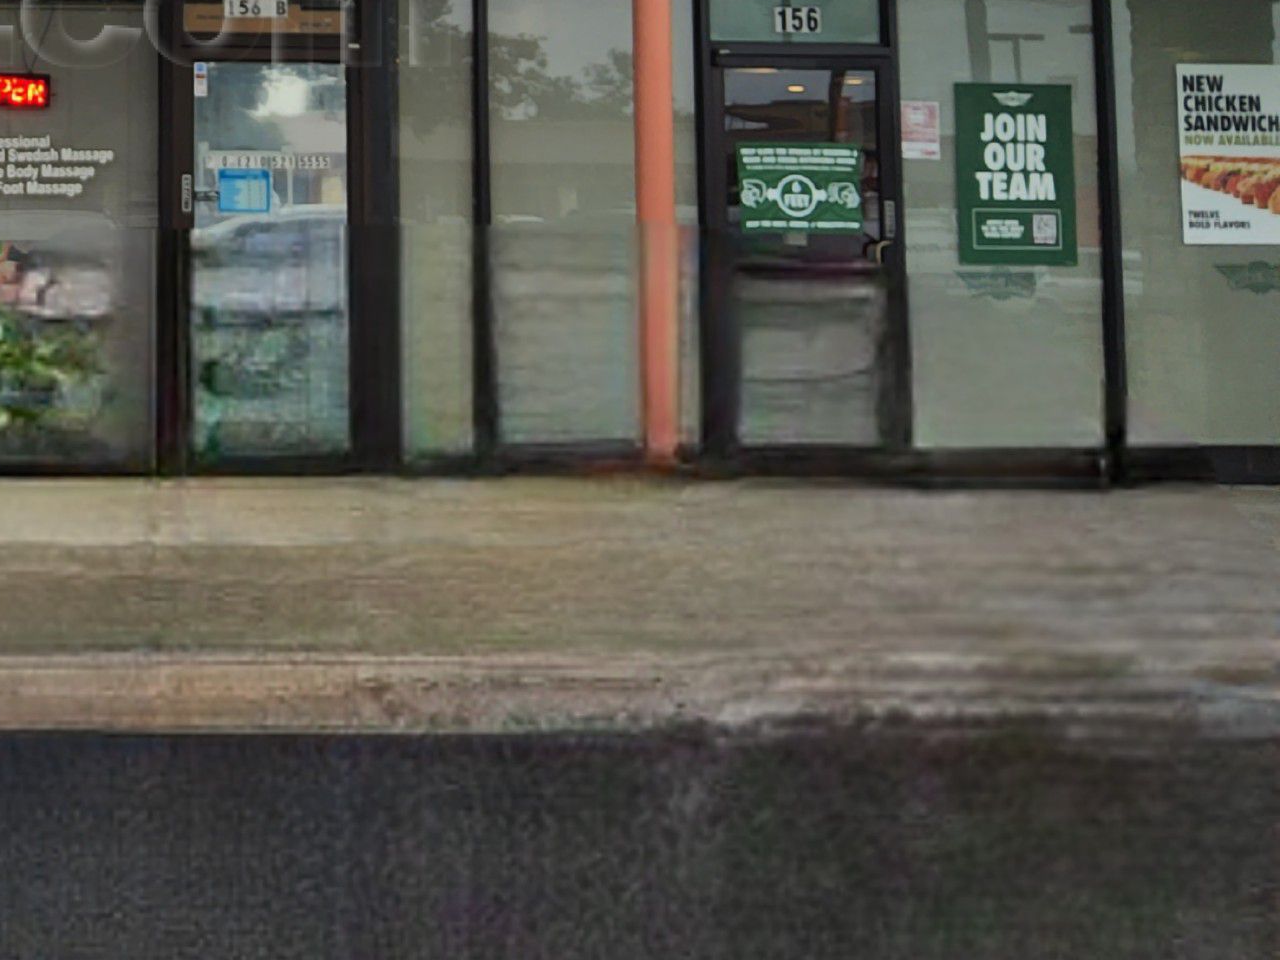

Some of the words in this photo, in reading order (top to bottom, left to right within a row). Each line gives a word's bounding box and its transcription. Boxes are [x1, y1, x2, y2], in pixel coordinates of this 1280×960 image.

[228, 1, 261, 16] 156
[276, 2, 286, 16] B
[778, 7, 818, 32] 156
[1182, 75, 1223, 93] NEW
[1183, 95, 1261, 112] CHICKEN
[980, 113, 1047, 142] JOIN
[1183, 114, 1280, 132] SANDWICH
[8, 148, 59, 162] Swedish
[61, 147, 114, 164] Massage
[983, 142, 1046, 171] OUR
[6, 164, 39, 180] Body
[41, 164, 95, 180] Massage
[26, 181, 83, 197] Massage
[975, 171, 1056, 201] TEAM
